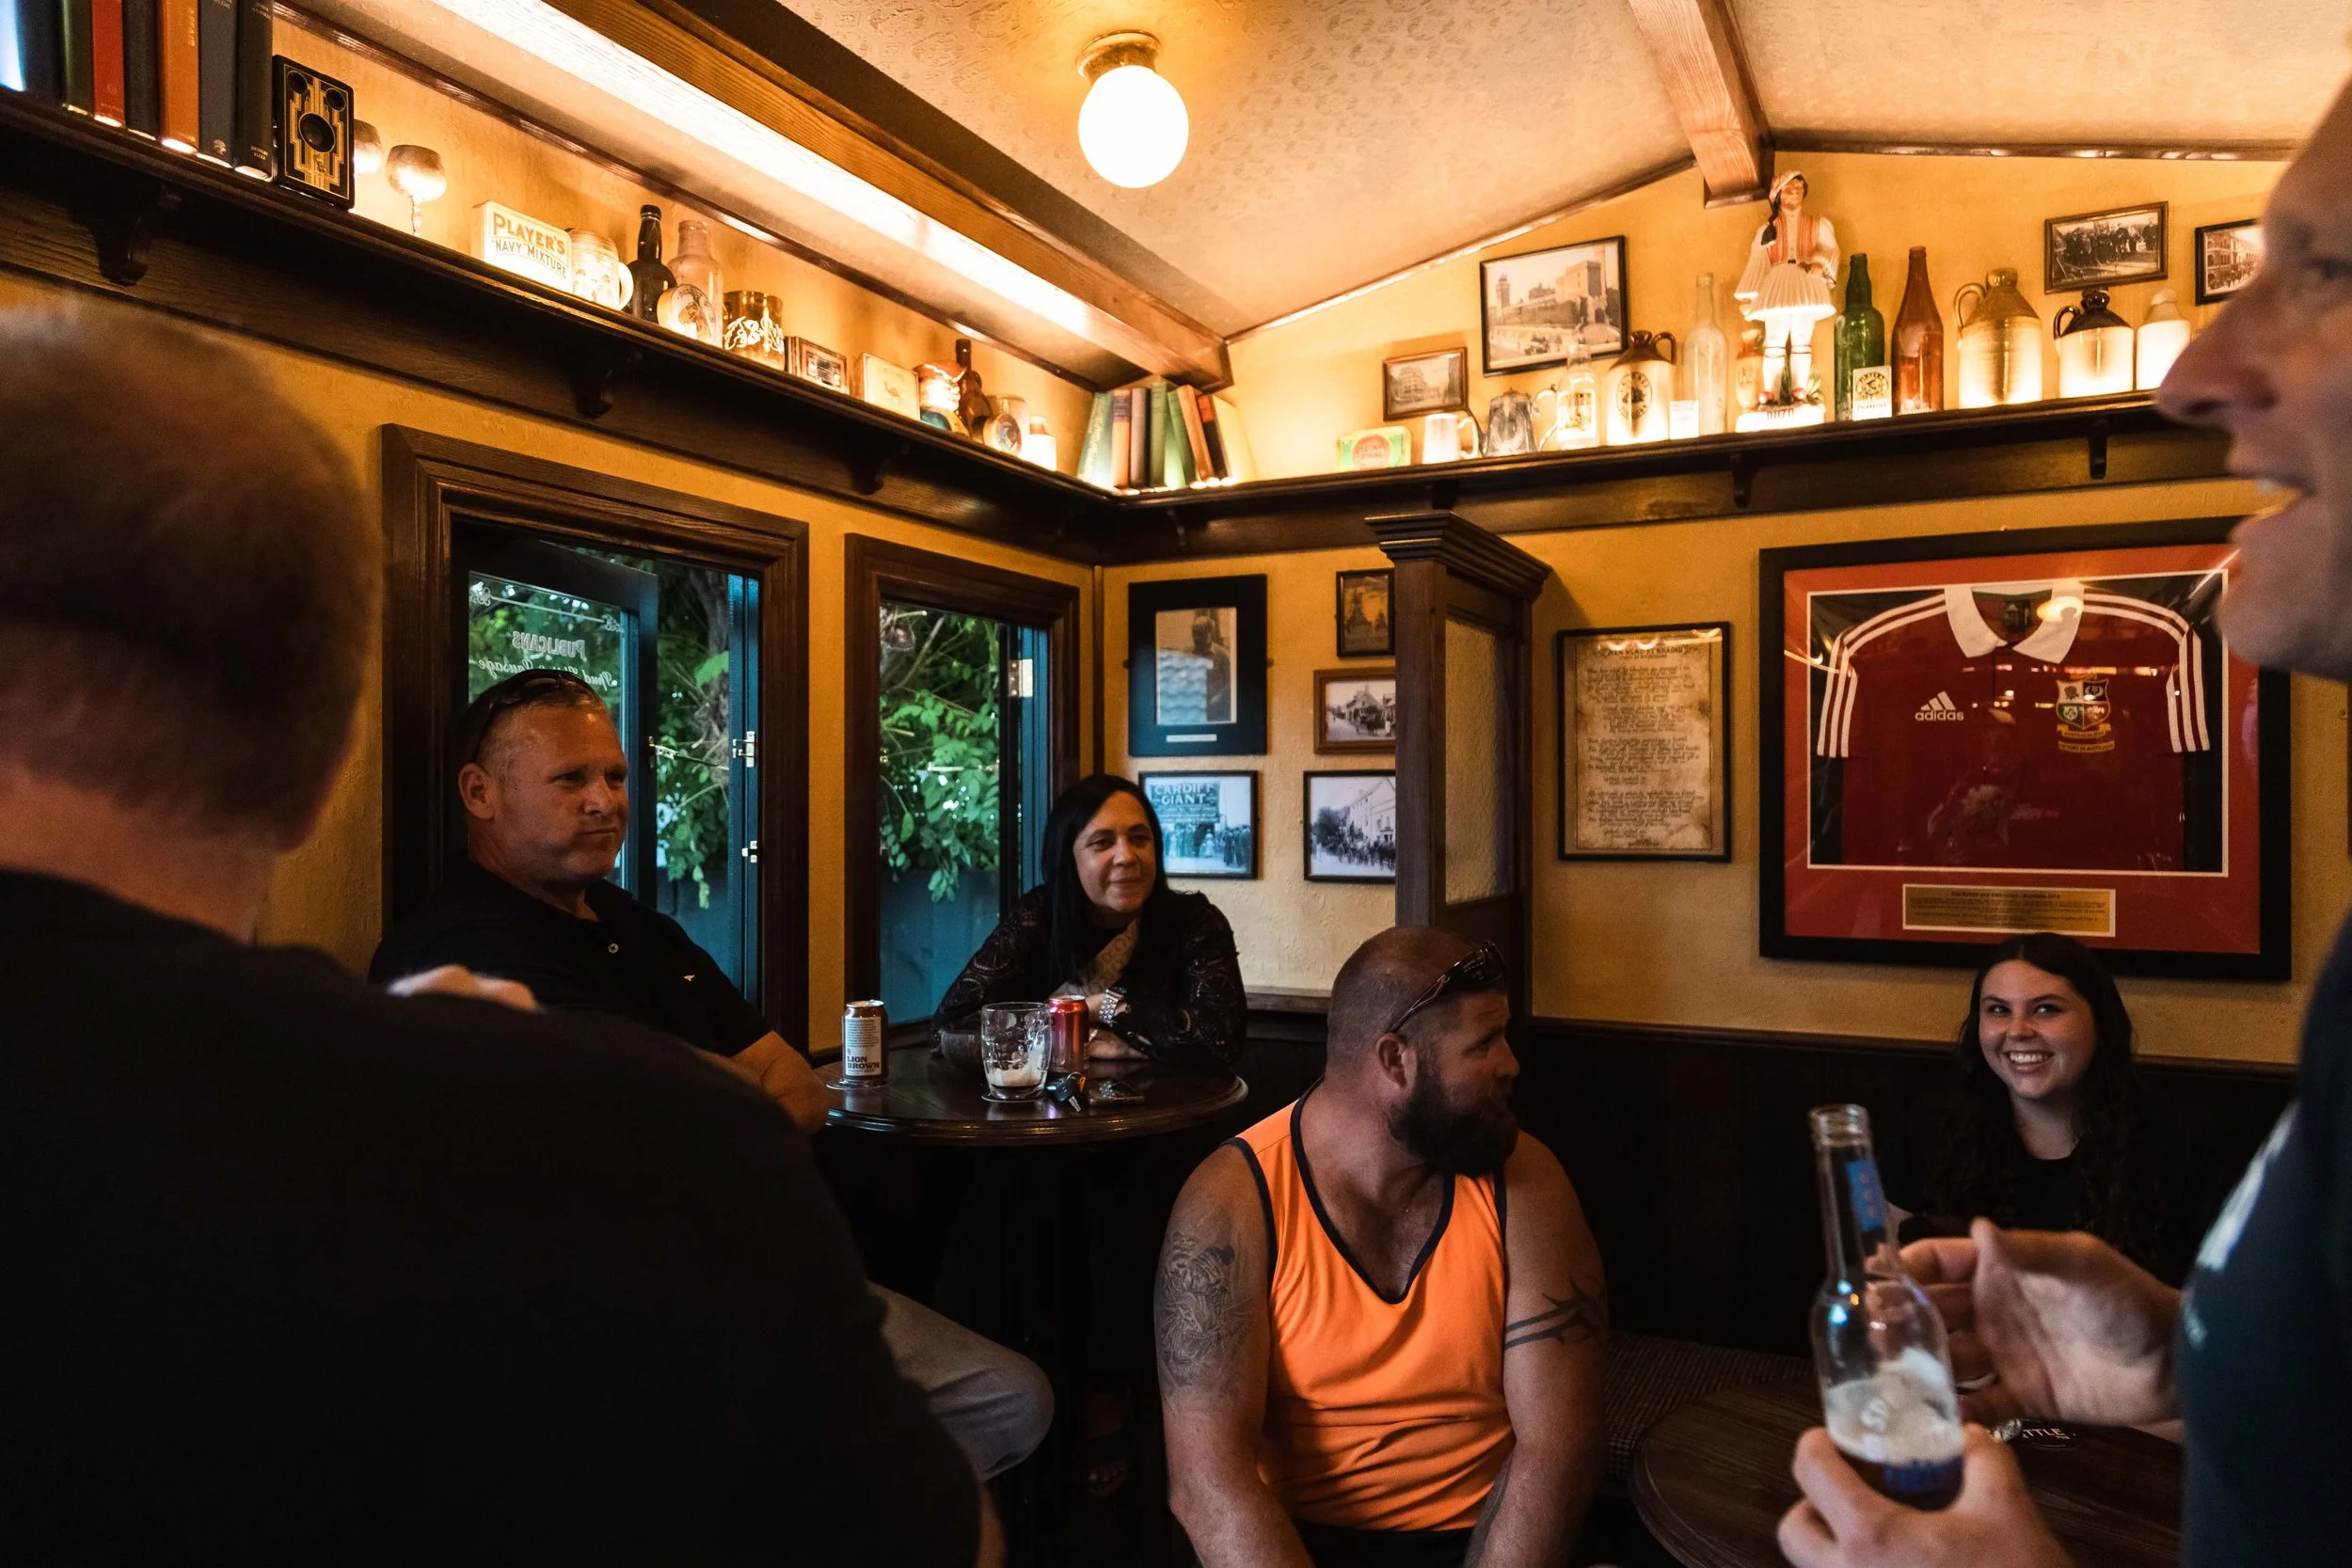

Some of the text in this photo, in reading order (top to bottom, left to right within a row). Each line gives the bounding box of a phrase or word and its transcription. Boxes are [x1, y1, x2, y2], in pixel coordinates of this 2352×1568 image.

[492, 212, 566, 256] PLAYER'S
[527, 245, 567, 279] MIXTURE
[1915, 708, 1964, 721] adidas
[1161, 793, 1206, 805] GIANT
